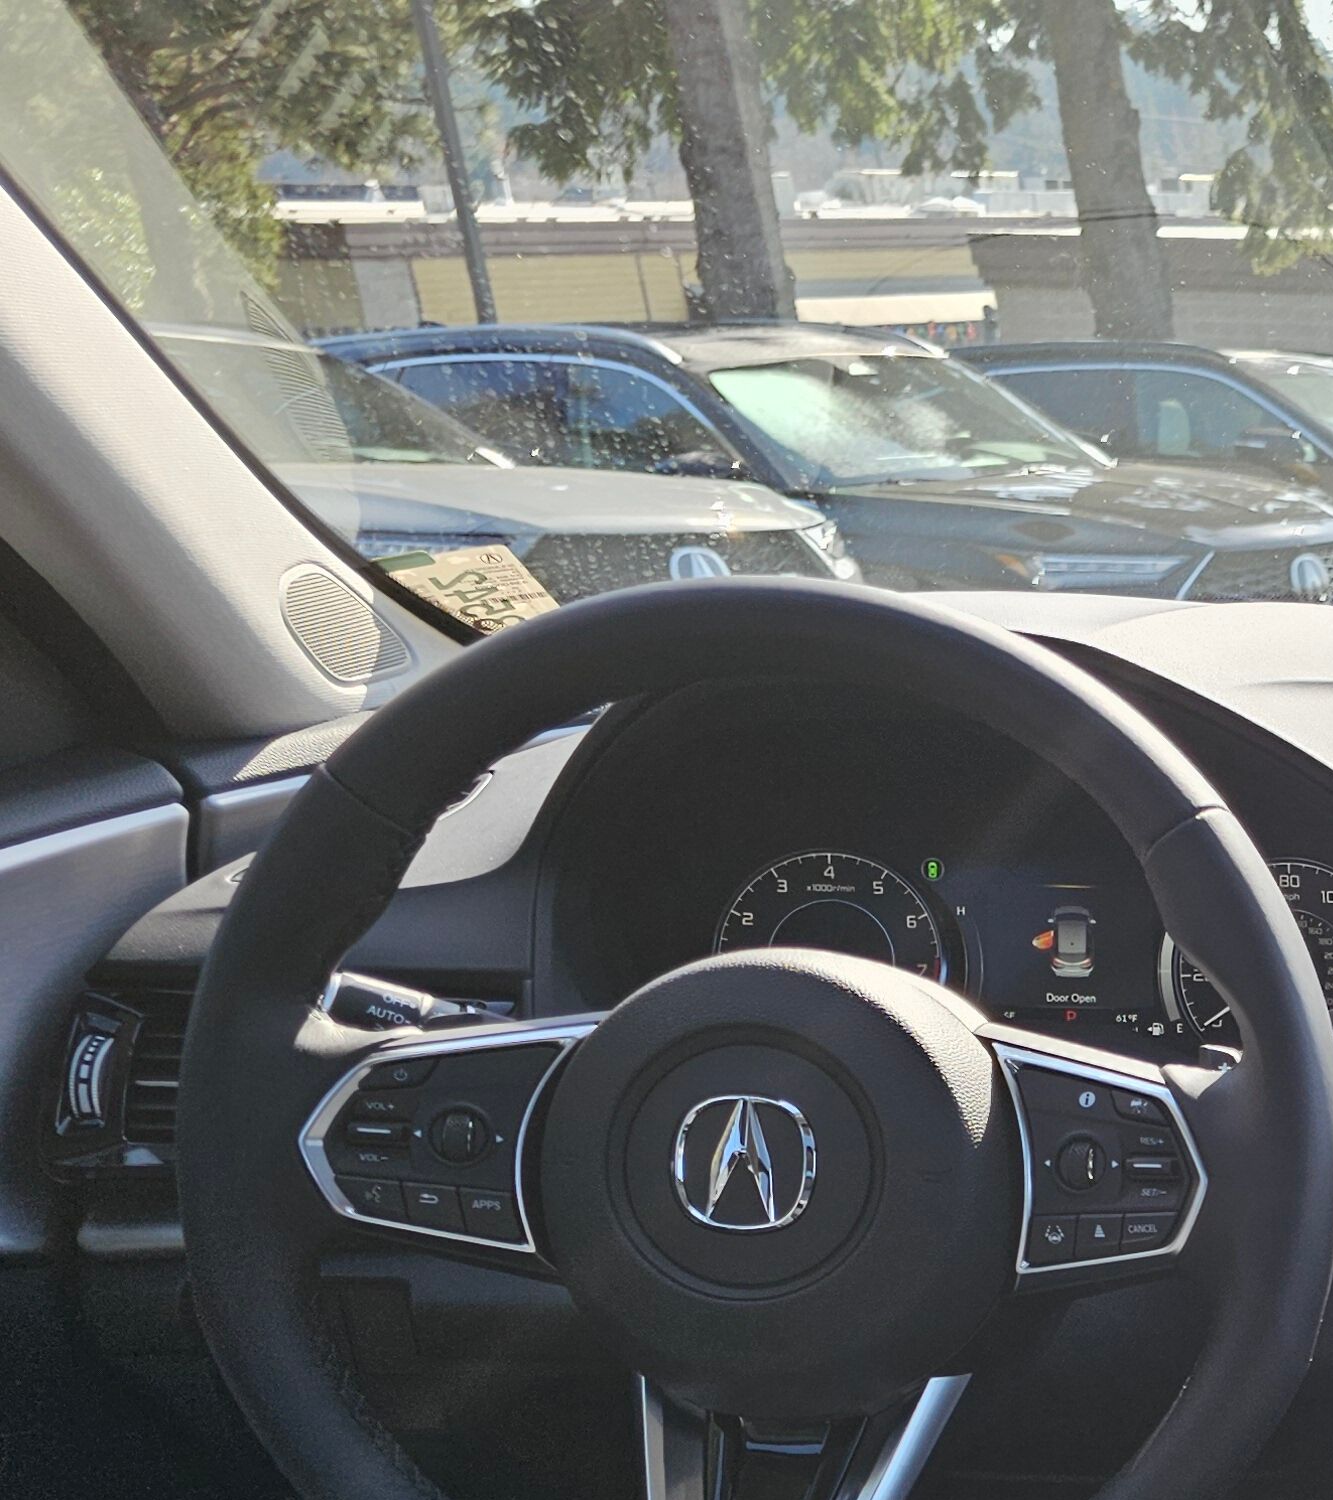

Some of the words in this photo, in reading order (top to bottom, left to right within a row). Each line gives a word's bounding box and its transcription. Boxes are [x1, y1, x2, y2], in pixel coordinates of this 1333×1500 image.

[822, 866, 836, 880] 4
[776, 879, 789, 894] 3
[872, 881, 885, 895] 5
[1279, 874, 1300, 888] 80
[956, 906, 966, 916] H
[741, 911, 754, 926] 2
[905, 914, 918, 929] 6
[1046, 992, 1069, 1004] Door
[1070, 993, 1097, 1006] Open
[366, 1004, 405, 1025] AUTO
[1064, 1010, 1077, 1023] P
[1176, 1023, 1184, 1034] E
[471, 1199, 502, 1211] APPS
[1127, 1224, 1158, 1234] CANCEL
